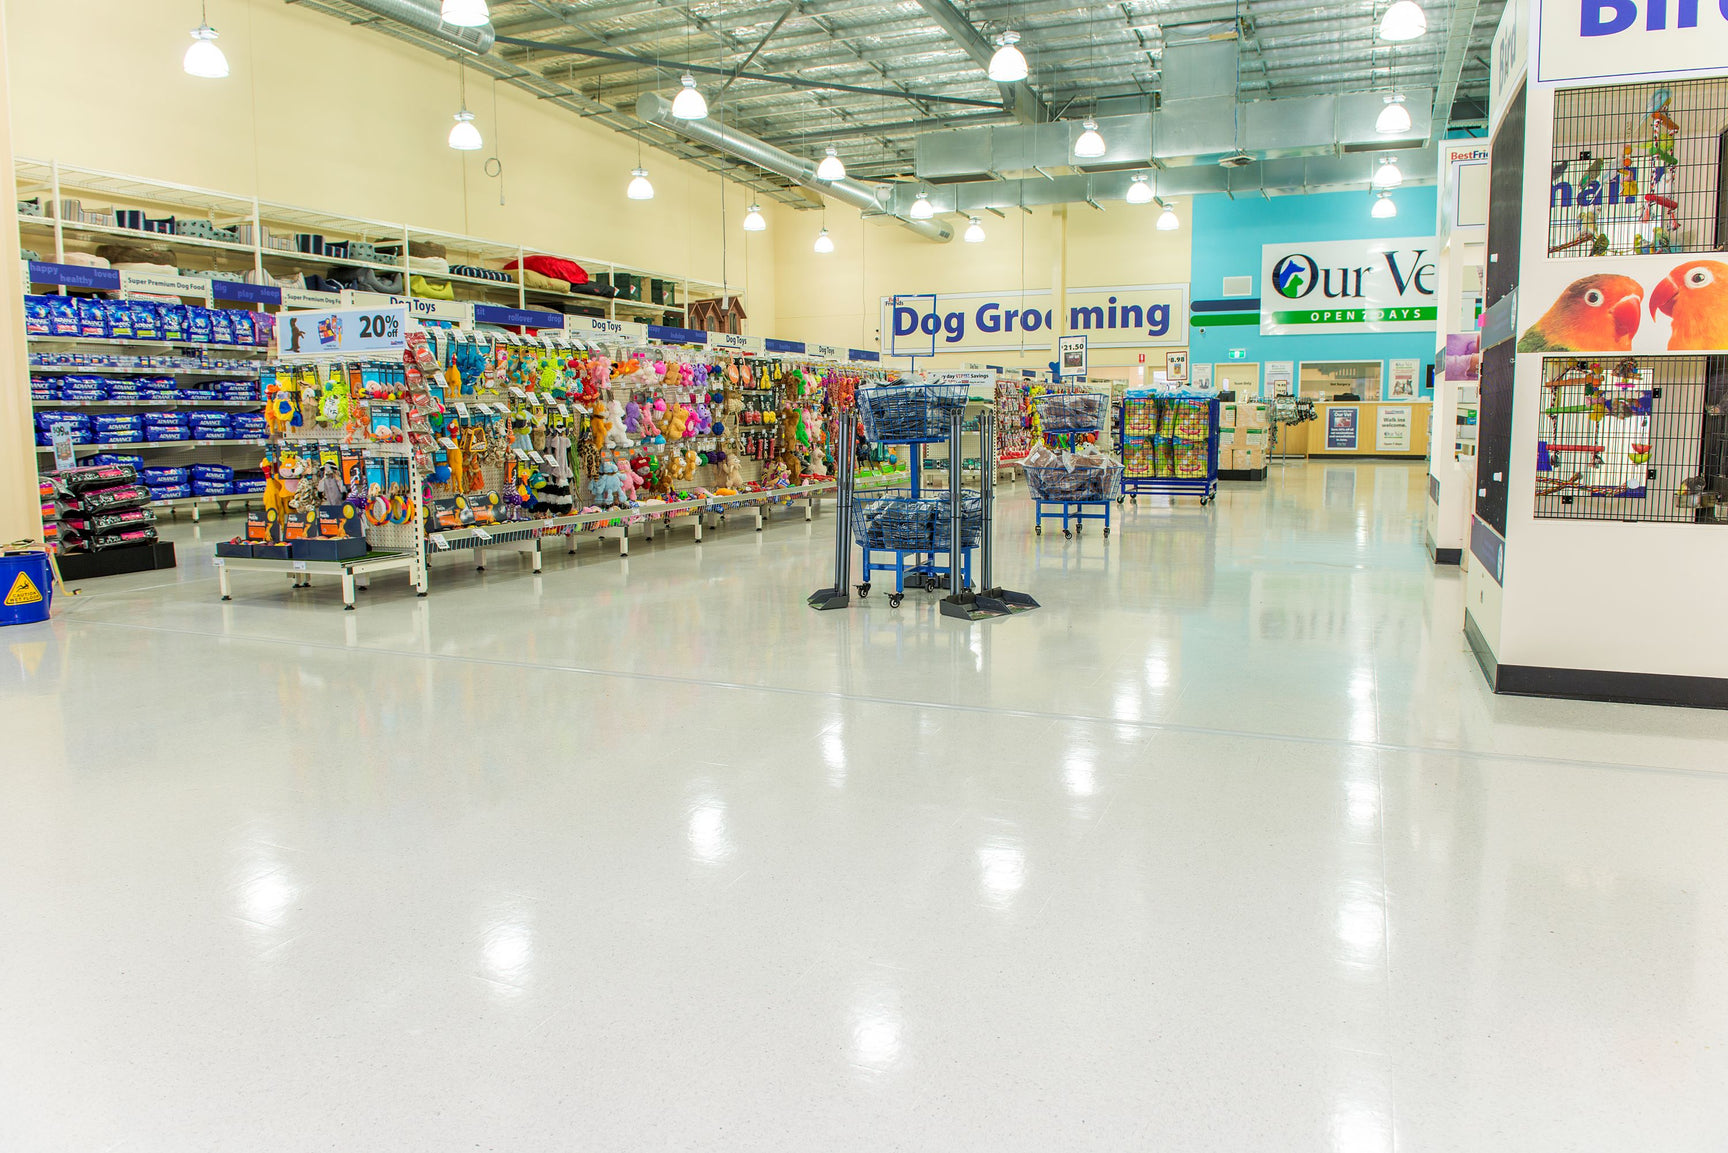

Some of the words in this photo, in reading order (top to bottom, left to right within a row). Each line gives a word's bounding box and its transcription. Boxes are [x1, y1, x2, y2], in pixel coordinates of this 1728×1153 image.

[1451, 150, 1489, 160] BestFri
[29, 262, 59, 275] happy
[94, 269, 118, 279] loved
[1271, 253, 1375, 299] Our
[60, 274, 93, 286] healthy
[127, 277, 147, 286] Super
[147, 279, 176, 288] Premium
[176, 282, 189, 291] Dog
[189, 283, 205, 291] Food
[214, 283, 227, 293] dig
[260, 288, 280, 298] sleep
[237, 289, 254, 300] play
[287, 294, 302, 302] Super
[302, 295, 324, 303] Premium
[325, 297, 334, 305] Dog
[414, 299, 436, 314] Toys
[476, 308, 485, 316] sit
[547, 314, 562, 325] drop
[508, 314, 533, 323] rollover
[1310, 311, 1355, 321] OPEN
[1376, 309, 1421, 320] DAYS
[359, 314, 399, 338] 20%
[591, 319, 606, 331] Dog
[607, 320, 622, 333] Toys
[894, 306, 965, 343] Dog
[387, 328, 398, 338] off
[725, 334, 736, 345] Dog
[736, 335, 747, 345] Toys
[818, 345, 827, 355] Dog
[827, 346, 835, 355] Toys
